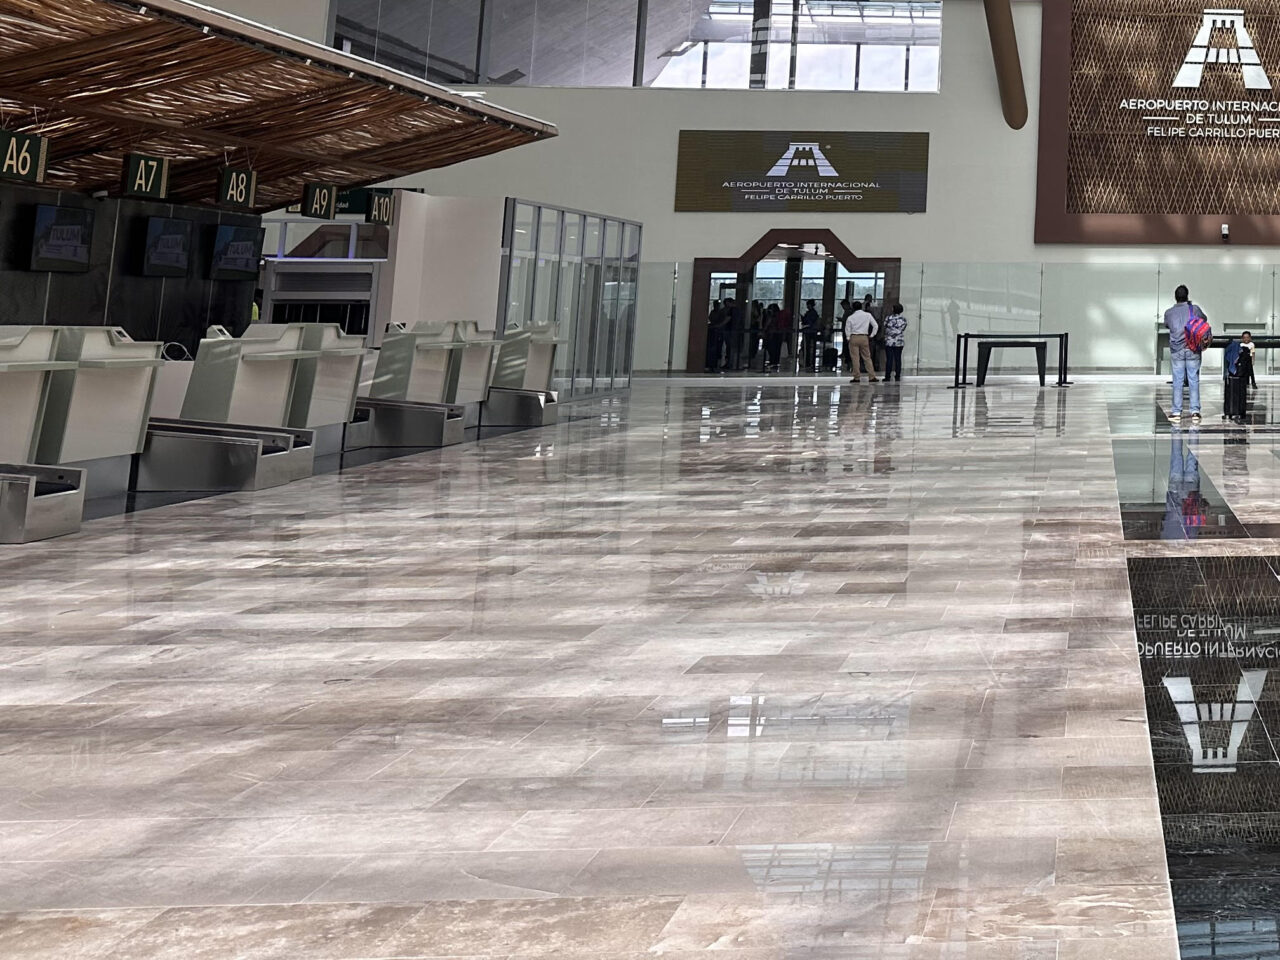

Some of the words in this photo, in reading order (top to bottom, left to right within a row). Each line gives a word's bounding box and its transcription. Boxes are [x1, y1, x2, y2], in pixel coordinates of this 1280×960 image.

[1119, 98, 1209, 111] AEROPUERTO
[1147, 126, 1186, 137] FELIPE
[1188, 127, 1246, 138] CARRILLO
[1186, 113, 1204, 124] DE
[1207, 113, 1252, 125] TULUM
[2, 137, 31, 175] A6
[134, 159, 158, 192] A7
[227, 172, 246, 203] A8
[797, 181, 881, 189] INTERNACIONAL
[311, 188, 329, 215] A9
[371, 196, 390, 222] A10
